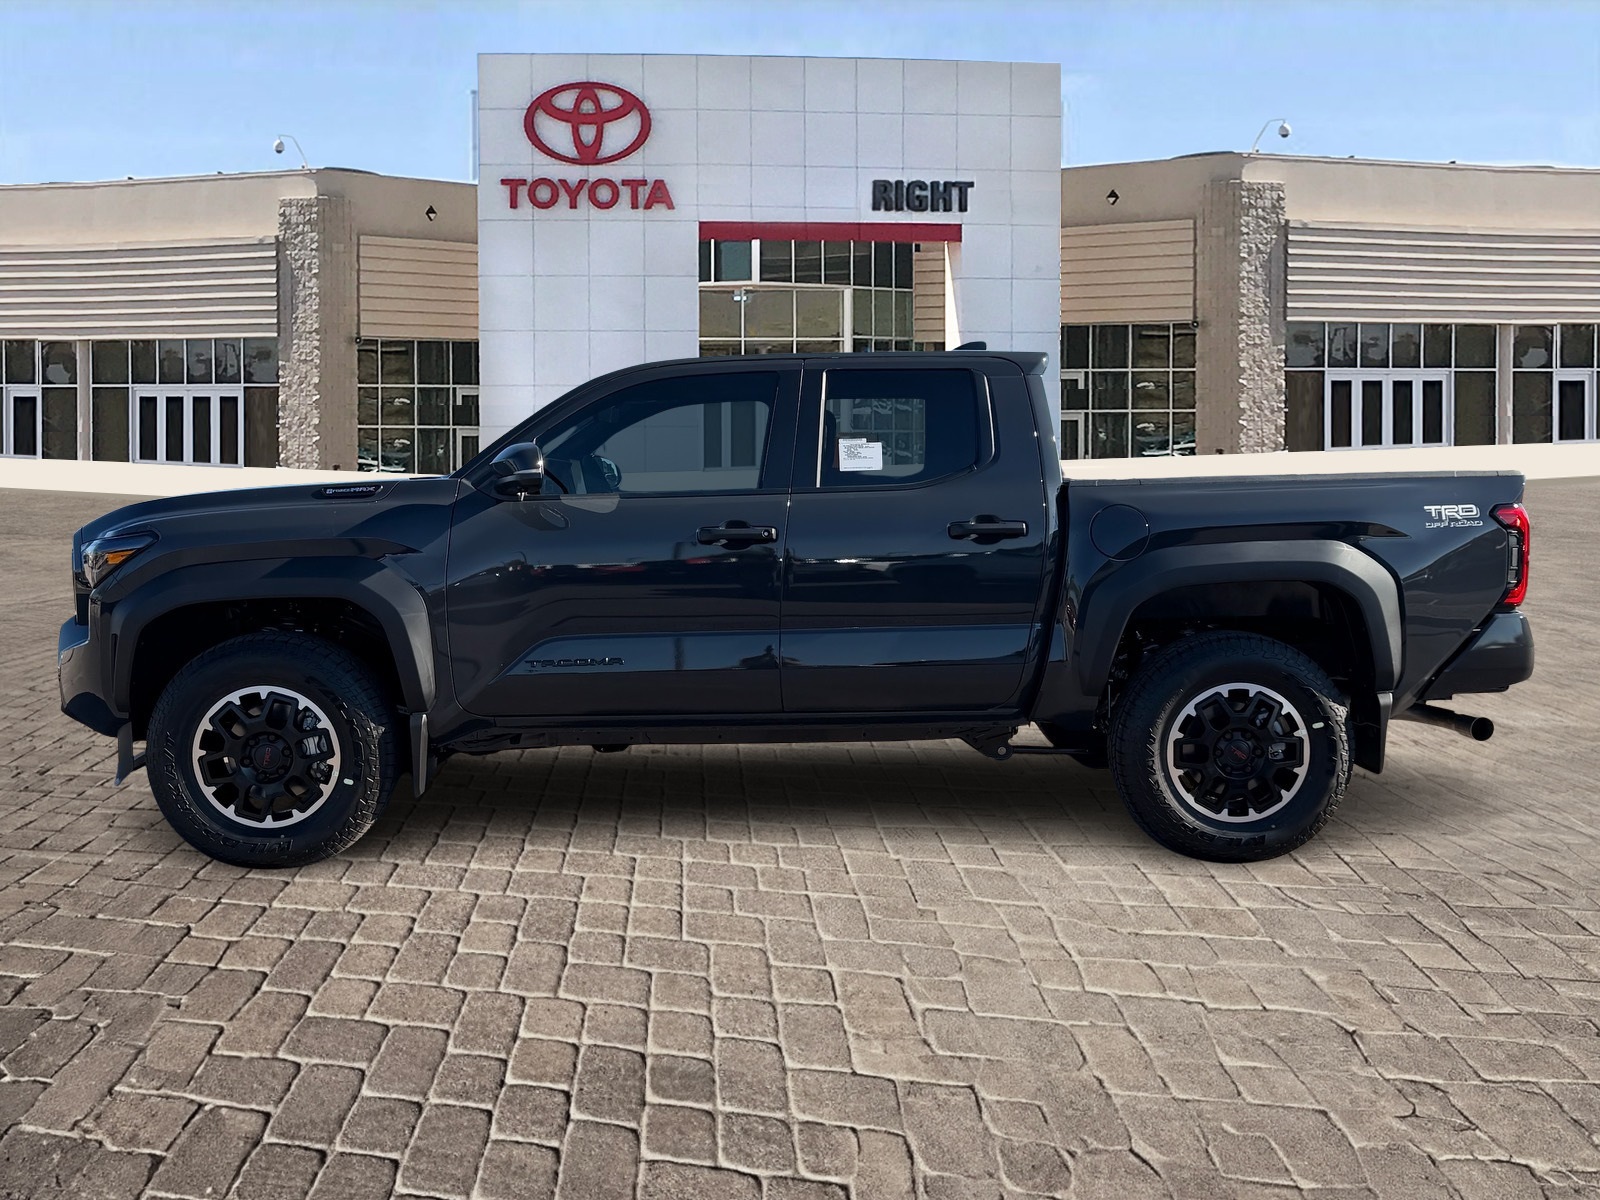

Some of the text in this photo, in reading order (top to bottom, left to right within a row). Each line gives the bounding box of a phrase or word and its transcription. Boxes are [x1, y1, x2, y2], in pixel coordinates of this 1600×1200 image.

[500, 178, 675, 210] TOYOTA
[872, 180, 974, 212] RIGHT
[1423, 504, 1480, 520] TRD
[524, 657, 626, 667] TACOMA
